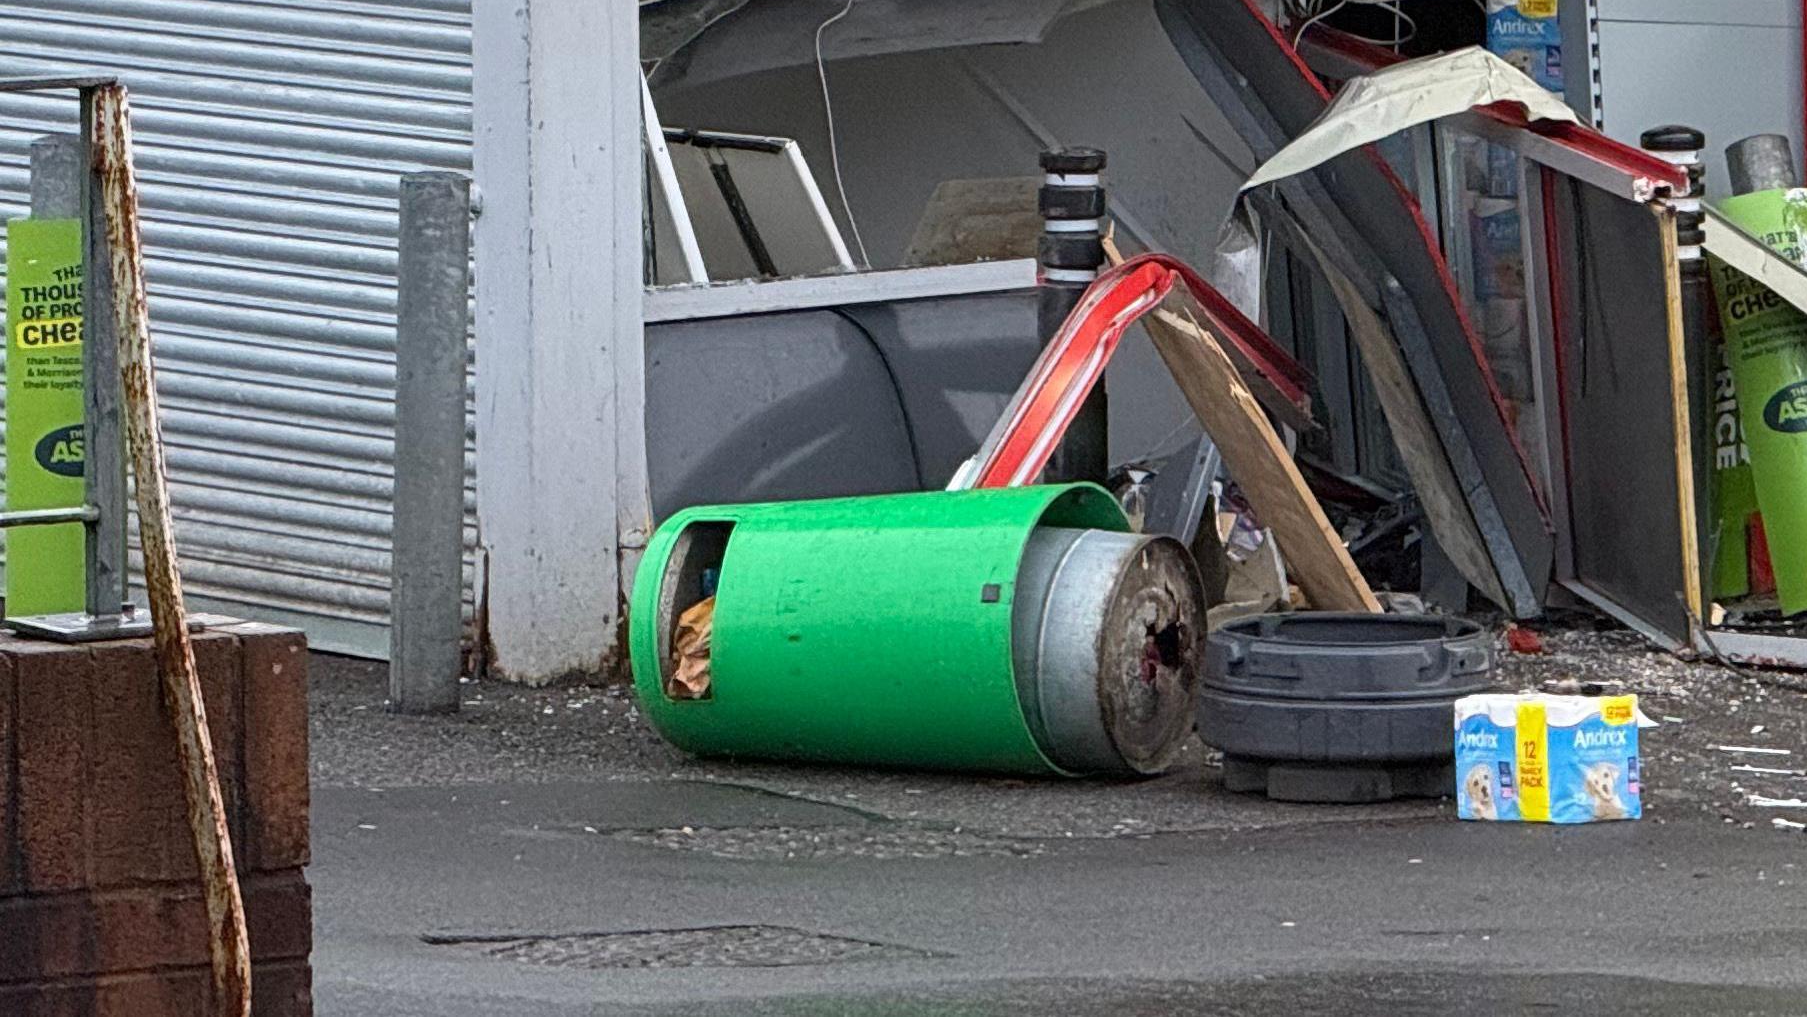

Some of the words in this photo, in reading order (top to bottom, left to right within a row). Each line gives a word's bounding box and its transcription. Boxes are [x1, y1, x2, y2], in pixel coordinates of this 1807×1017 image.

[1492, 18, 1547, 35] Andrex
[21, 305, 46, 320] OF
[1730, 289, 1781, 320] CHe
[1574, 728, 1626, 749] Andrex
[1524, 740, 1537, 759] 12
